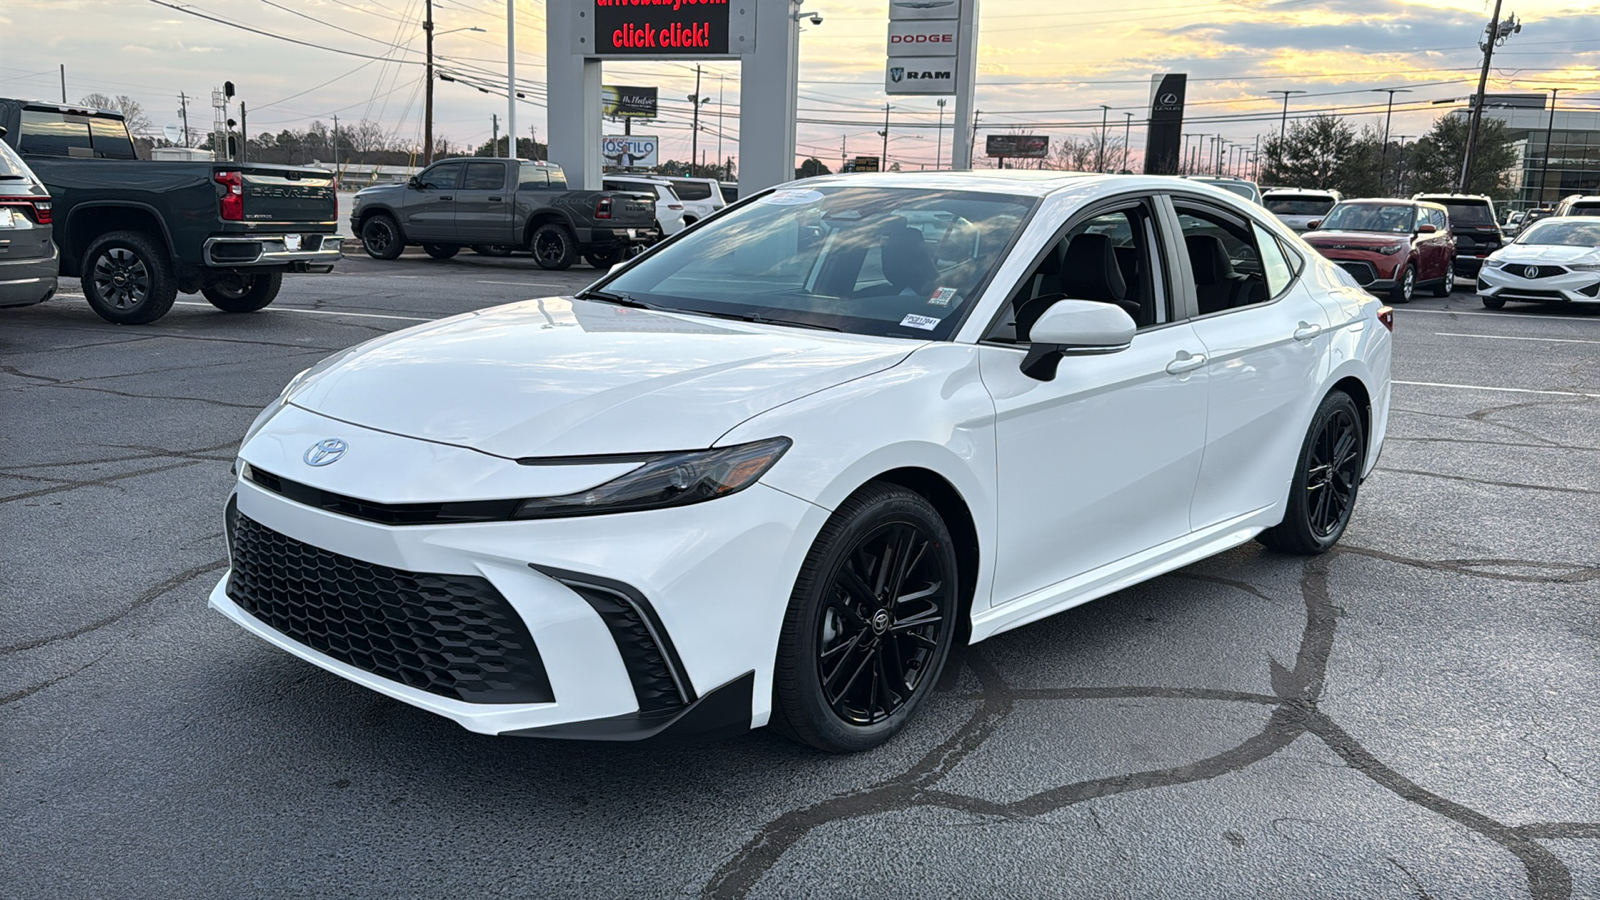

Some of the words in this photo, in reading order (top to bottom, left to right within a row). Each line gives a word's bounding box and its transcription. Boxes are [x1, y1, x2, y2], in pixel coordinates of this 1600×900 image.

[613, 23, 656, 48] click
[659, 22, 710, 48] click!
[891, 34, 953, 43] DODGE
[907, 71, 951, 79] RAM
[603, 141, 654, 153] OSTILO
